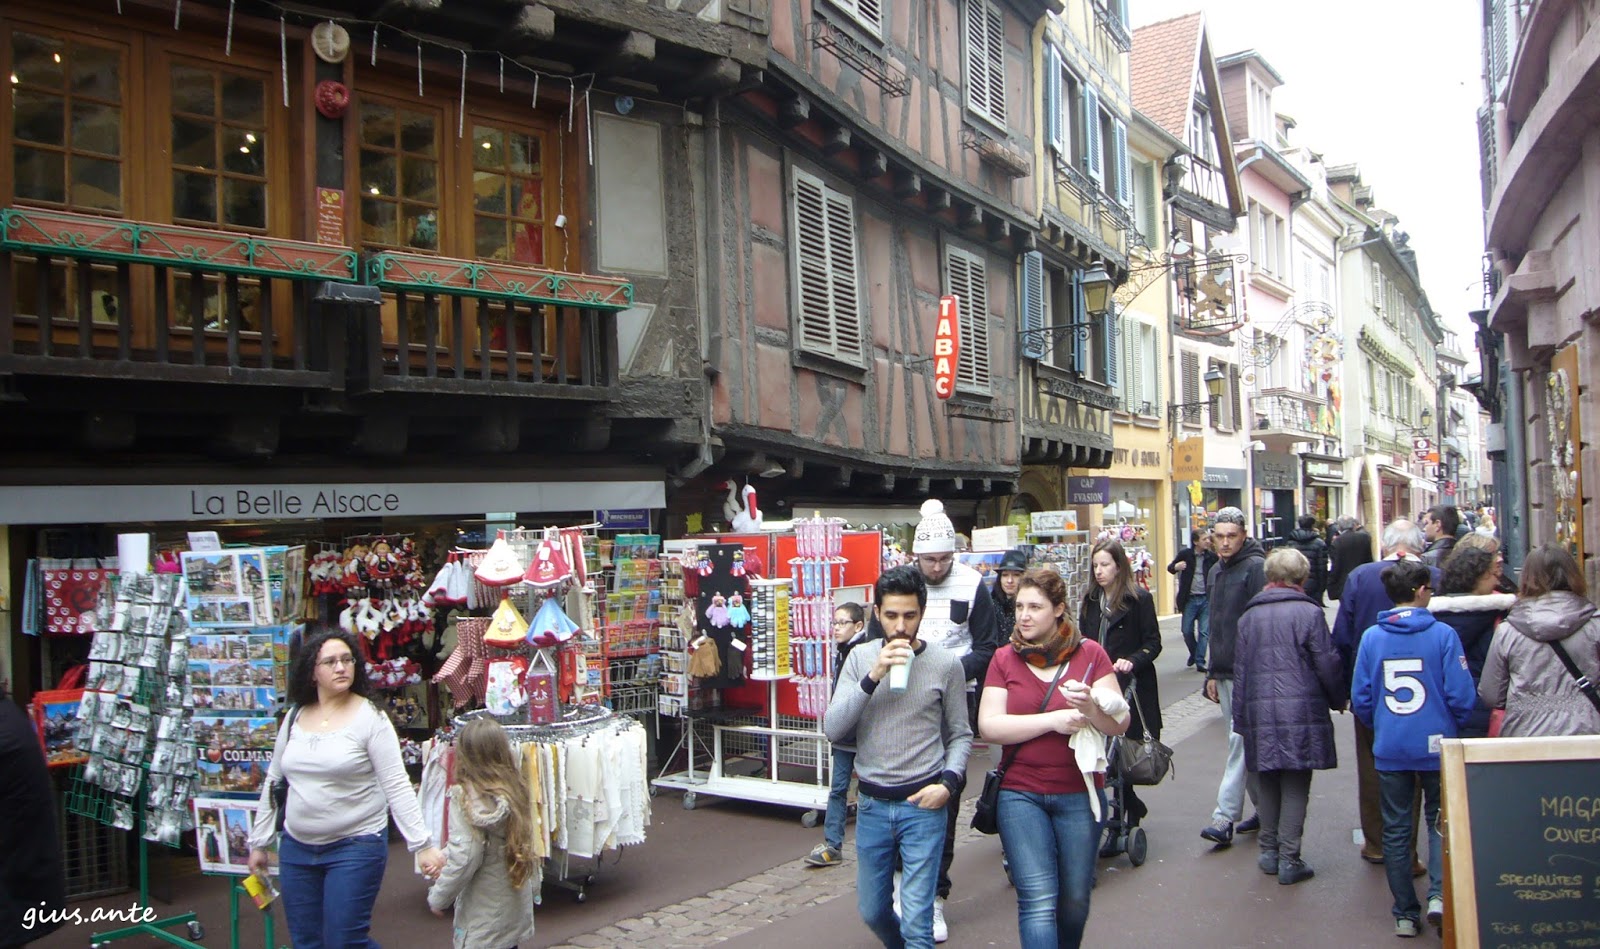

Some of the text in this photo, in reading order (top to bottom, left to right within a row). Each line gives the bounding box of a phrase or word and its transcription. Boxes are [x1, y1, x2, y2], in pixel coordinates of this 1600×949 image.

[935, 299, 953, 395] TABAC
[1113, 448, 1129, 465] UNT
[1080, 478, 1095, 488] CAP
[191, 489, 400, 515] La Belle Alsace
[1073, 493, 1103, 503] EVASION
[1382, 659, 1426, 716] 5
[223, 750, 273, 762] COLMAR
